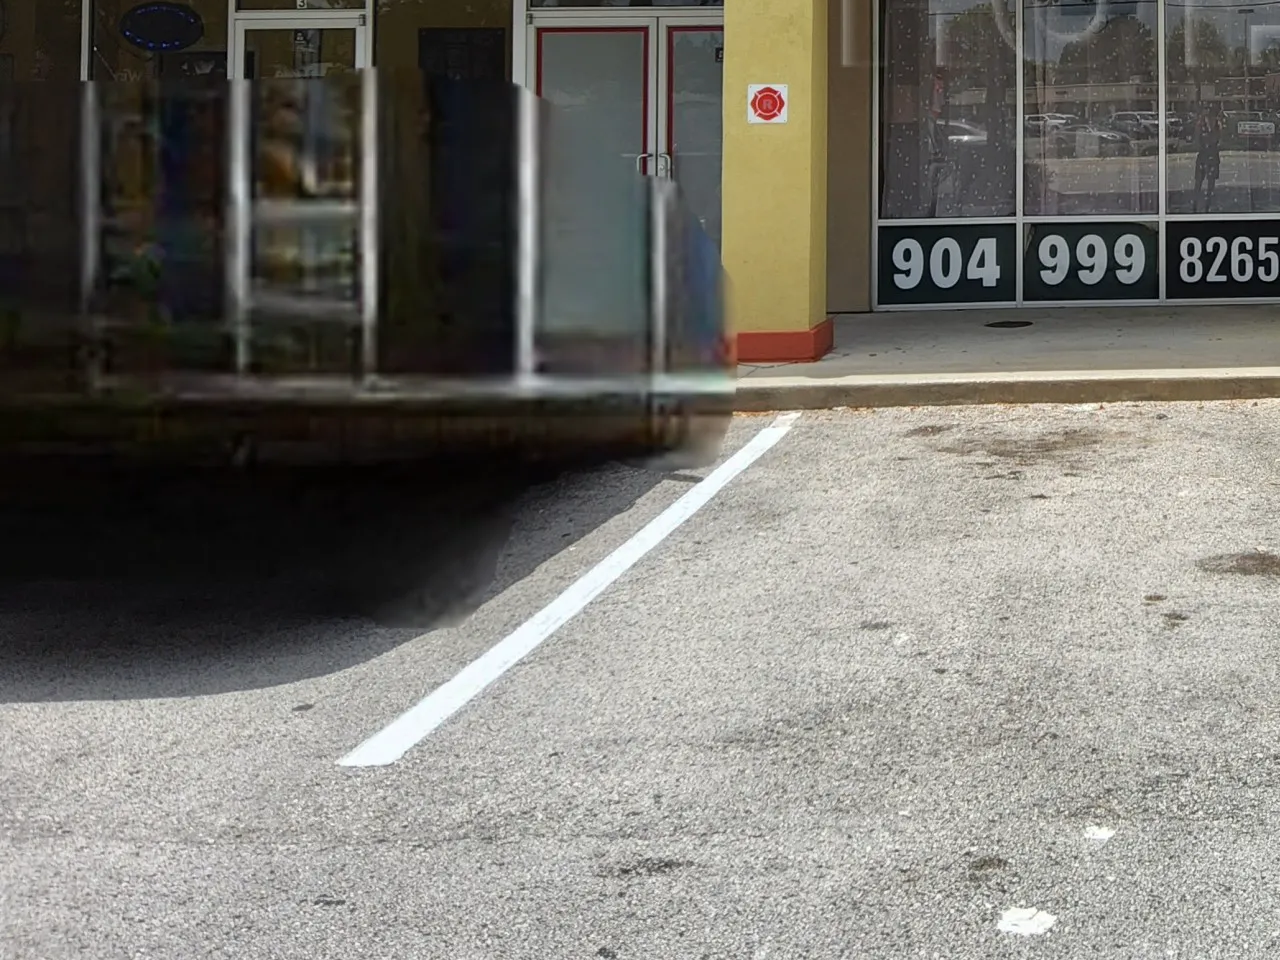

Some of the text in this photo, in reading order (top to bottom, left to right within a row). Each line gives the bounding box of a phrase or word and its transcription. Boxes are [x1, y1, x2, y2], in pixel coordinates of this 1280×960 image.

[762, 99, 772, 109] R
[891, 234, 1280, 290] 904 999 8265
